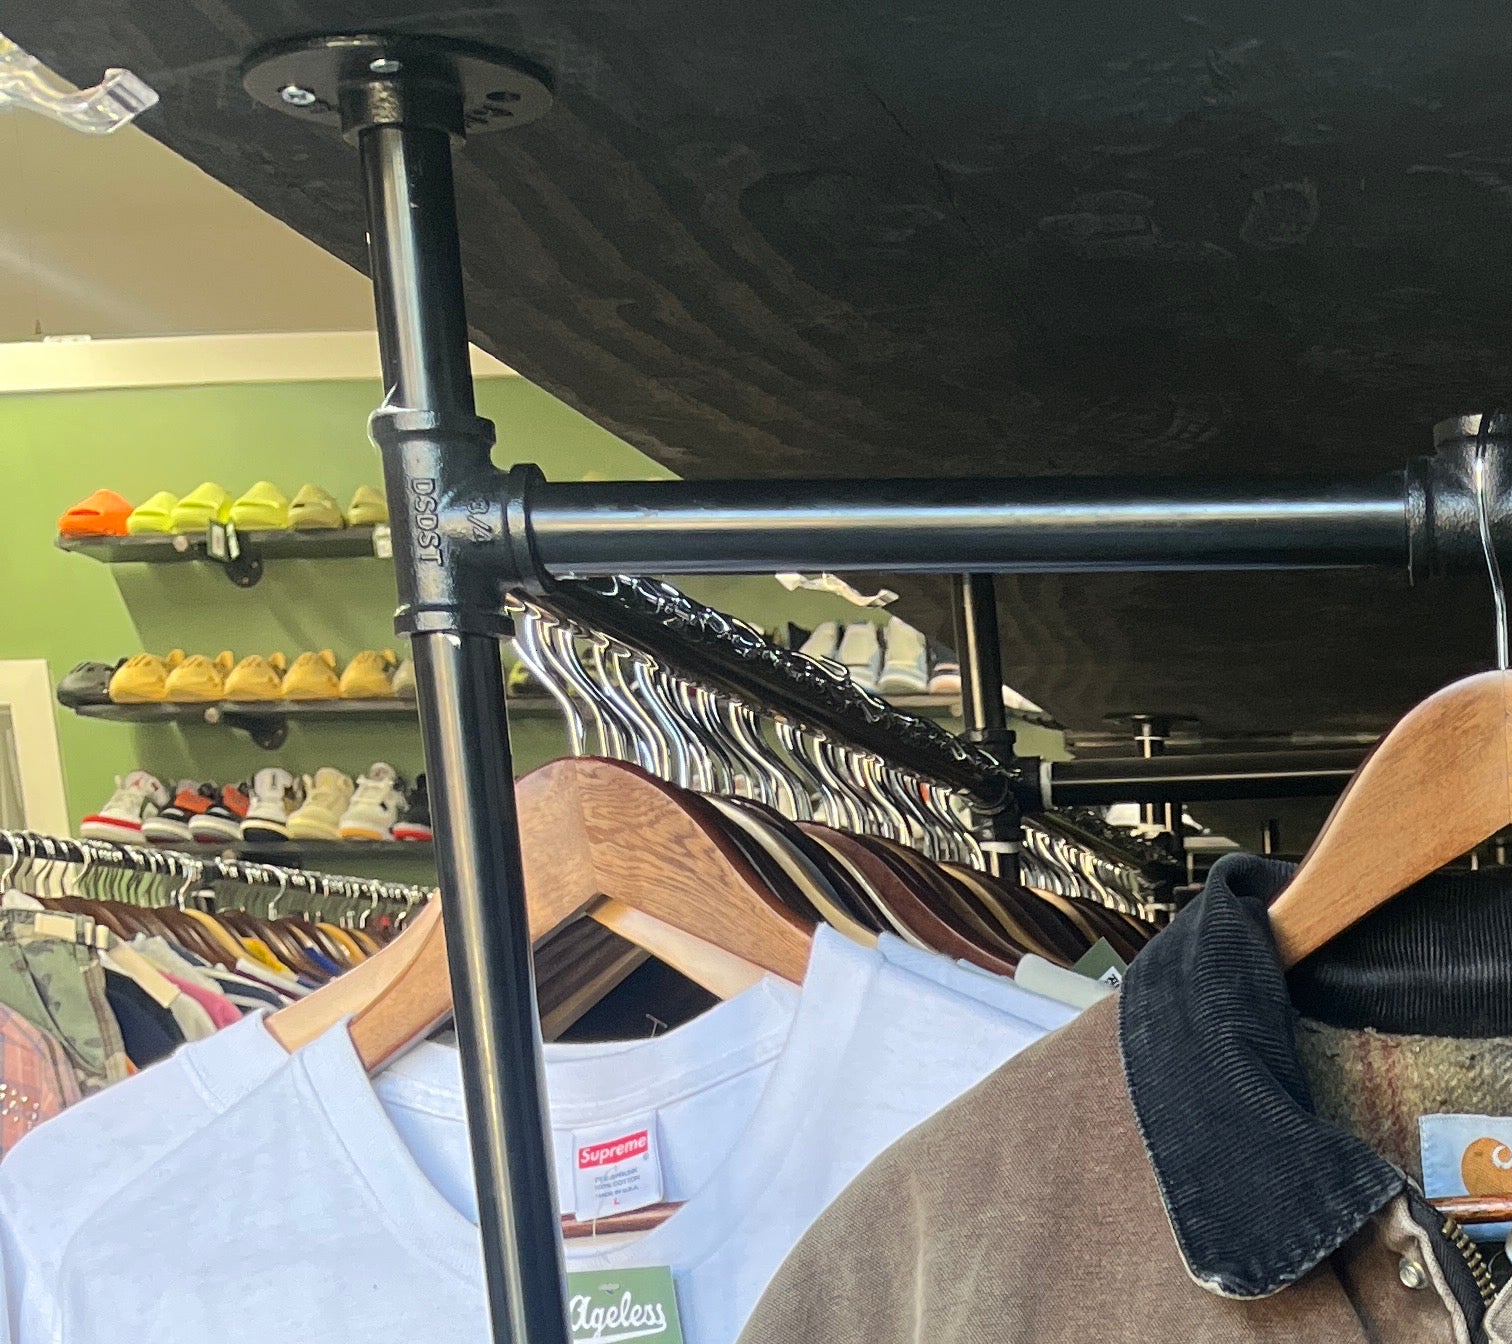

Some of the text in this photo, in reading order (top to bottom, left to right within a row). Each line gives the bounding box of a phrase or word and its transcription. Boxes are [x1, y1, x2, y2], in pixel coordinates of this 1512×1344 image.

[410, 478, 444, 567] DSDST
[580, 1135, 648, 1164] Supreme
[613, 1197, 620, 1205] L
